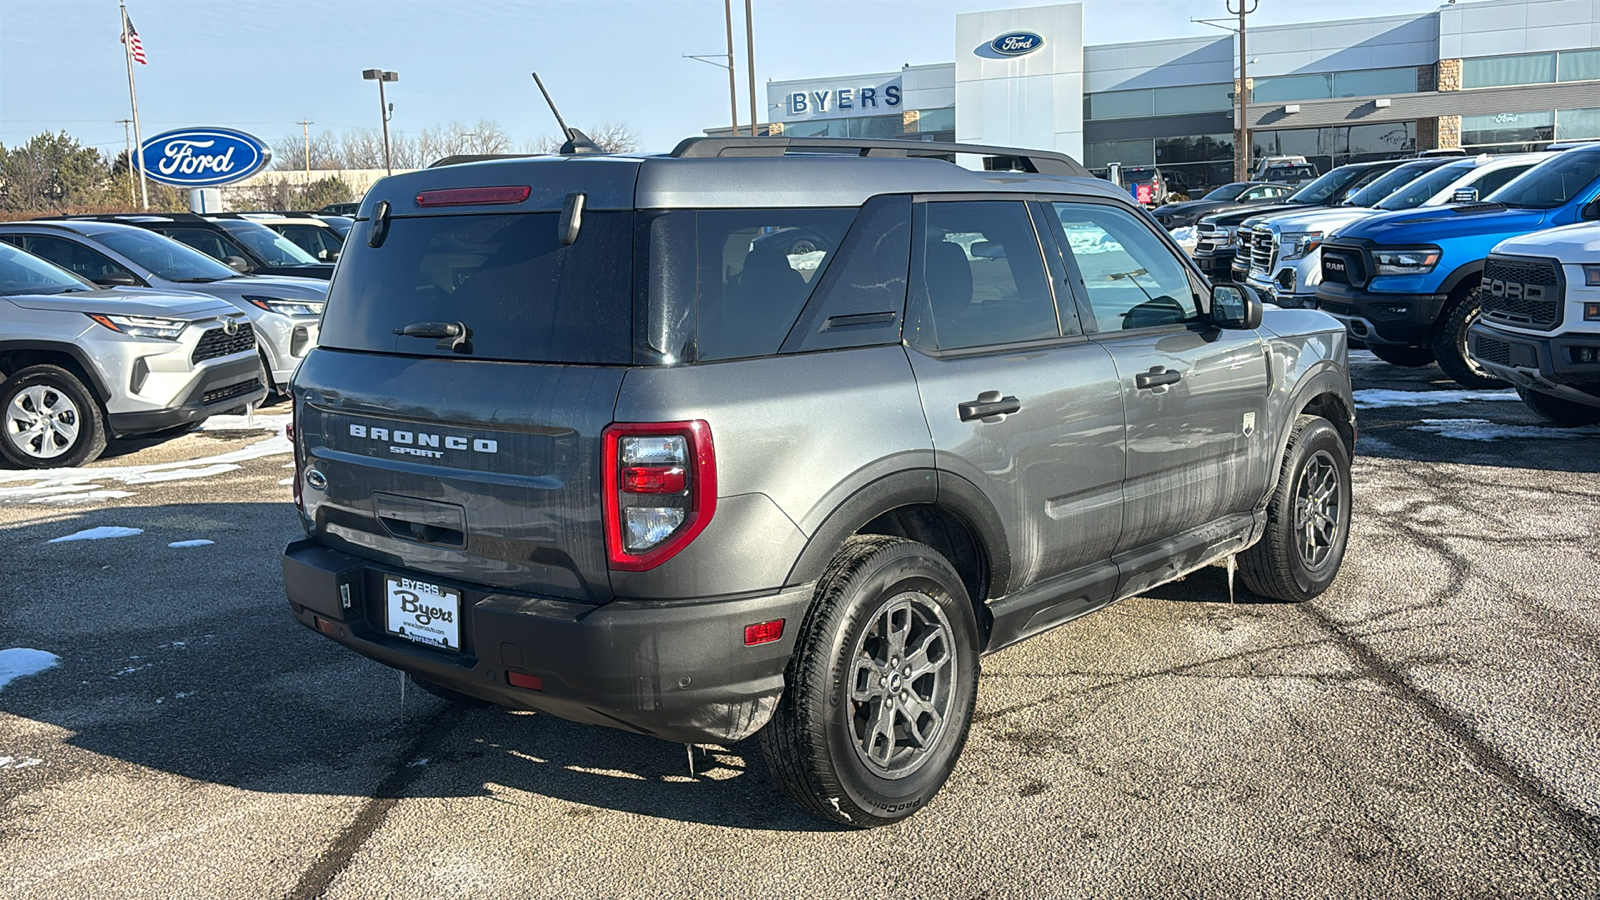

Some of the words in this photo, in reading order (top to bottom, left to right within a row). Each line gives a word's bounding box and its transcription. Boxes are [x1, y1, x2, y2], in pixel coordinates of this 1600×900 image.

[1002, 36, 1032, 50] Ford
[792, 85, 900, 114] BYERS
[159, 140, 235, 175] Ford
[1325, 262, 1345, 271] RAM
[1481, 278, 1546, 301] FORD
[349, 423, 498, 453] BRONCO
[389, 445, 444, 459] SPORT
[401, 578, 439, 596] BYERS
[393, 590, 453, 626] Byers
